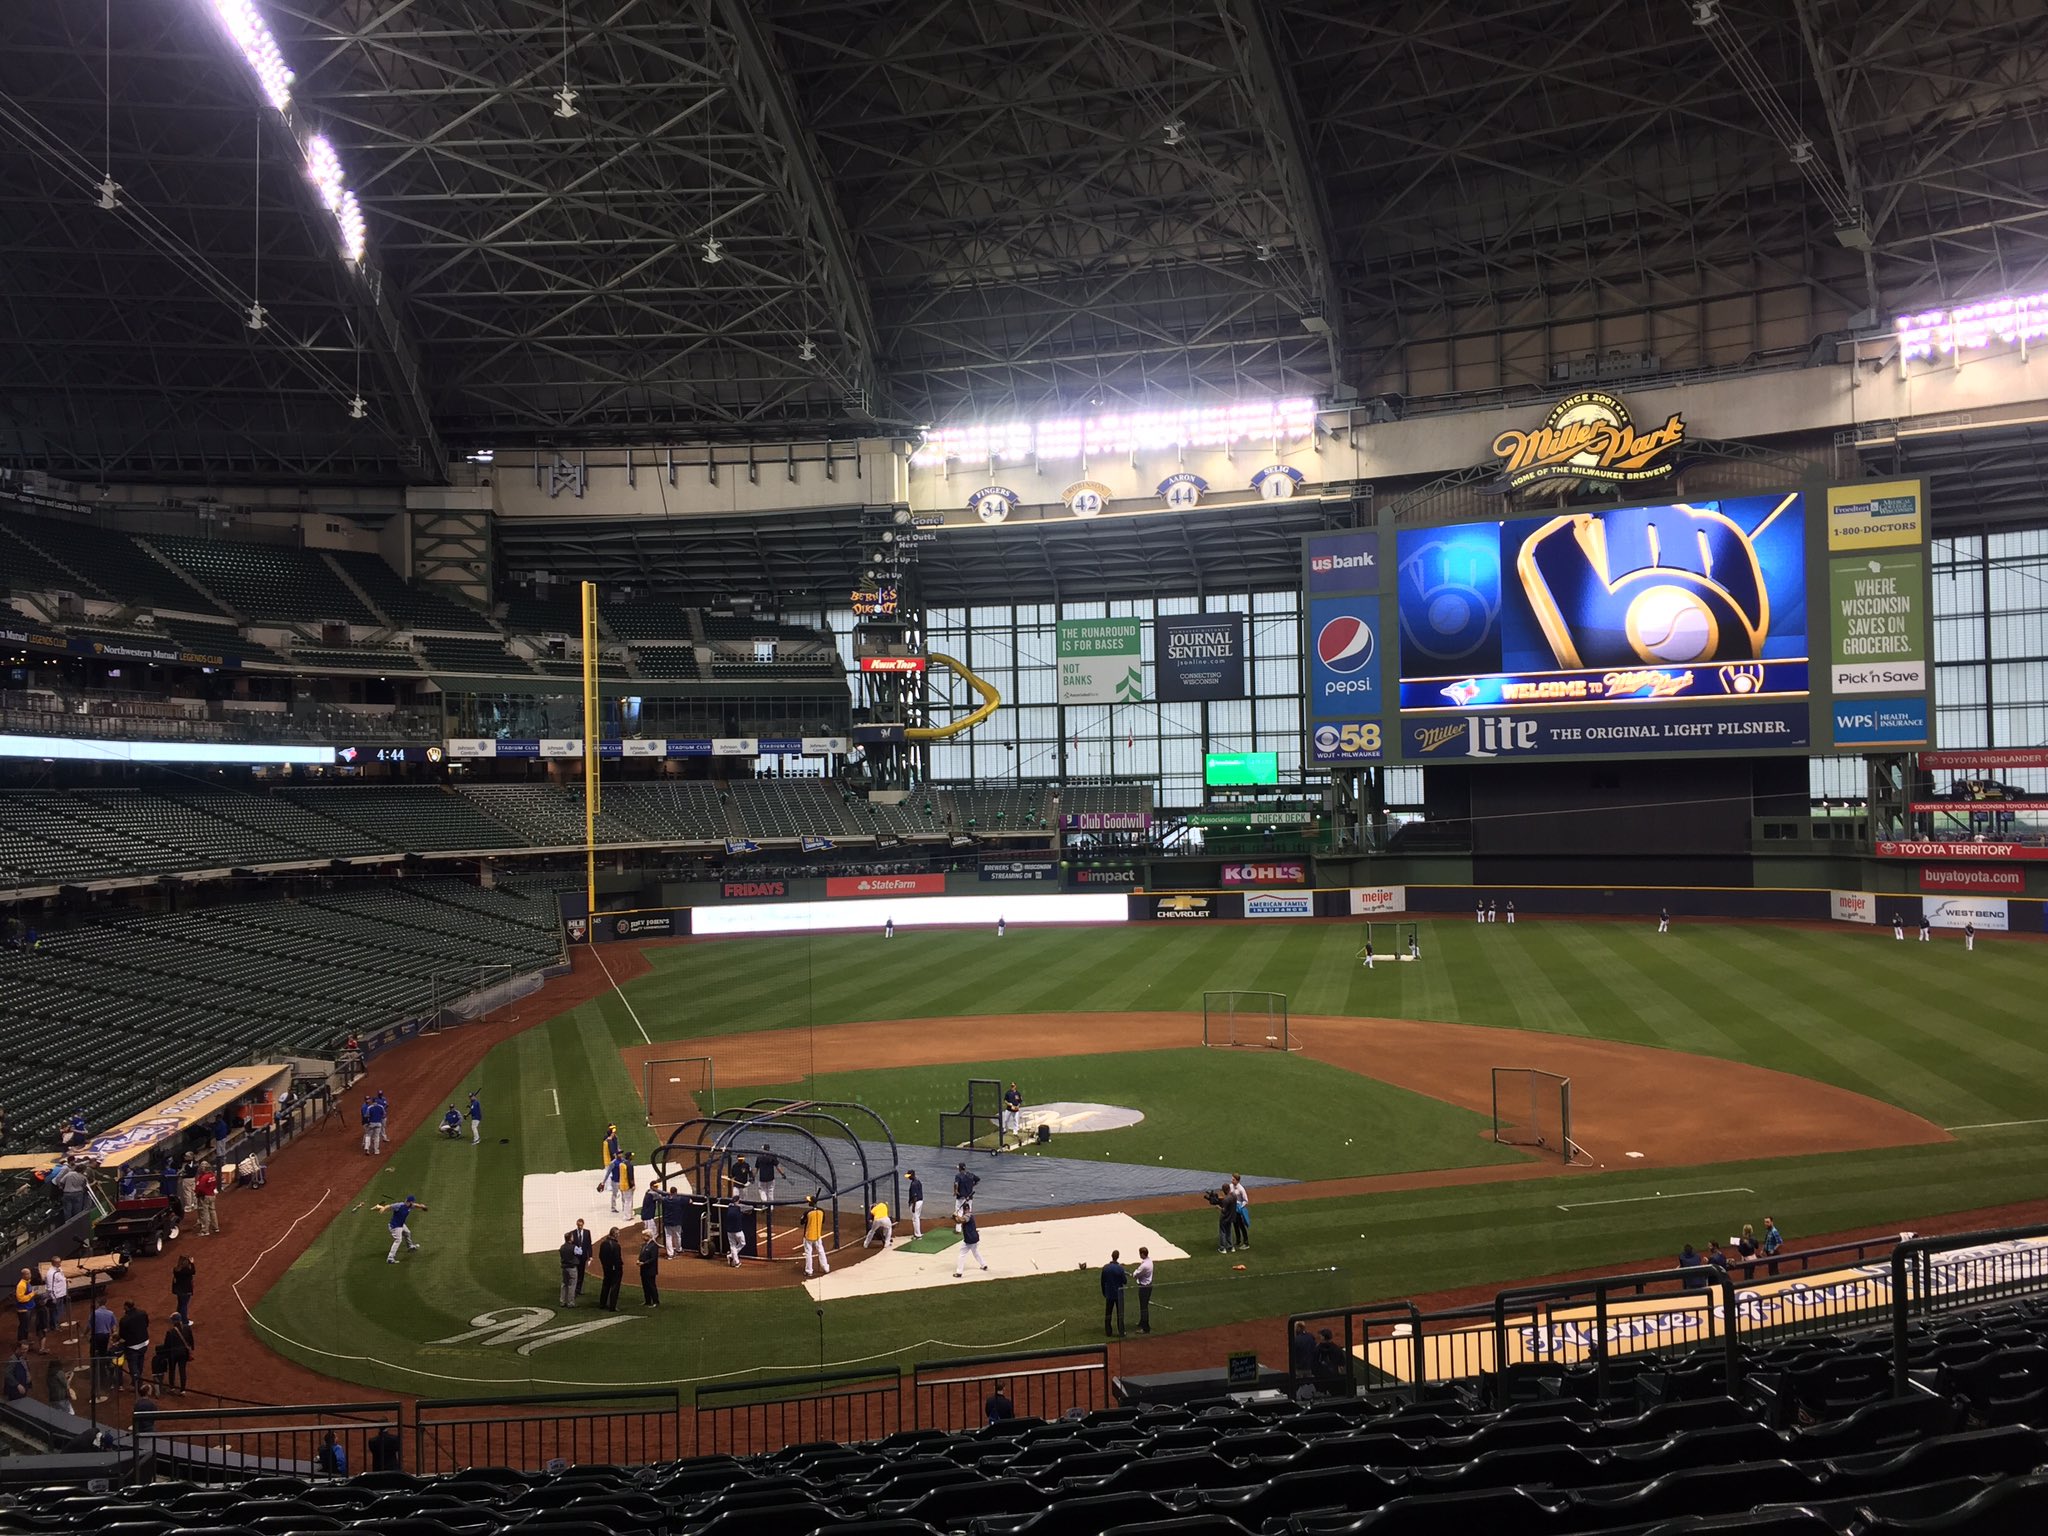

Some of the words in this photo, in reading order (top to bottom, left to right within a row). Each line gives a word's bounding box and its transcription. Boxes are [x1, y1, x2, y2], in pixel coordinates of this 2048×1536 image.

[1555, 393, 1590, 414] SINCE
[1592, 394, 1616, 408] 2001
[1492, 418, 1609, 473] Miller
[1592, 412, 1684, 469] Park
[1264, 465, 1289, 476] SELIG
[1510, 473, 1536, 488] HOME
[1537, 468, 1549, 477] OF
[1551, 466, 1569, 474] THE
[1571, 466, 1624, 480] MILWAUKEE
[1626, 464, 1672, 480] BREWERS
[1168, 474, 1196, 484] AARON
[976, 488, 1011, 499] FINGERS
[1068, 481, 1105, 494] ROBINSON
[1273, 480, 1281, 496] 1
[1075, 495, 1098, 510] 42
[1171, 488, 1193, 504] 44
[982, 501, 1004, 517] 34
[911, 516, 944, 525] Gone!
[1834, 522, 1916, 536] 1-800-DOCTORS
[1854, 578, 1896, 596] WHERE
[1841, 596, 1910, 616] WISCONSIN
[1061, 628, 1078, 638] THE
[1081, 626, 1136, 638] RUNAROUND
[1848, 616, 1886, 636] SAVES
[1888, 616, 1905, 633] ON
[1062, 640, 1071, 651] IS
[1074, 640, 1092, 650] FOR
[1095, 639, 1124, 650] BASES
[1168, 632, 1233, 647] JOURNAL
[1842, 635, 1912, 655] GROCERIES.
[104, 646, 152, 657] Northwestern
[153, 650, 178, 660] Mutual
[180, 652, 207, 663] LEGENDS
[207, 656, 223, 664] CLUB
[1168, 644, 1233, 659] SENTINEL
[1063, 664, 1080, 674] NOT
[1064, 675, 1092, 686] BANKS
[1838, 673, 1868, 684] Pick
[1882, 672, 1919, 682] Save
[1325, 676, 1370, 696] pepsi
[1501, 680, 1587, 699] WELCOME
[1589, 682, 1603, 693] TO
[1837, 714, 1873, 728] WPS
[1880, 719, 1923, 727] INSURANCE
[1340, 724, 1381, 752] 58
[1414, 723, 1467, 752] Miller
[1464, 716, 1538, 757] Lite
[1551, 728, 1581, 740] THE
[1586, 725, 1660, 740] ORIGINAL
[1664, 724, 1713, 736] LIGHT
[1718, 721, 1790, 735] PILSNER.
[377, 749, 405, 760] 4:44
[1980, 754, 2041, 763] HIGHLANDER
[1080, 815, 1100, 829] Club
[1103, 814, 1144, 829] Goodwill
[1257, 814, 1282, 823] CHECK
[1285, 813, 1305, 822] DECK
[1899, 844, 1946, 855] TOYOTA
[1949, 844, 2013, 855] TERRITORY
[1088, 870, 1135, 883] impact
[1225, 866, 1301, 880] KOHL'S
[1925, 870, 2019, 884] buyatoyota.com
[724, 882, 785, 896] FRIDAYS
[1362, 889, 1393, 904] meijer
[1840, 894, 1865, 911] meijer
